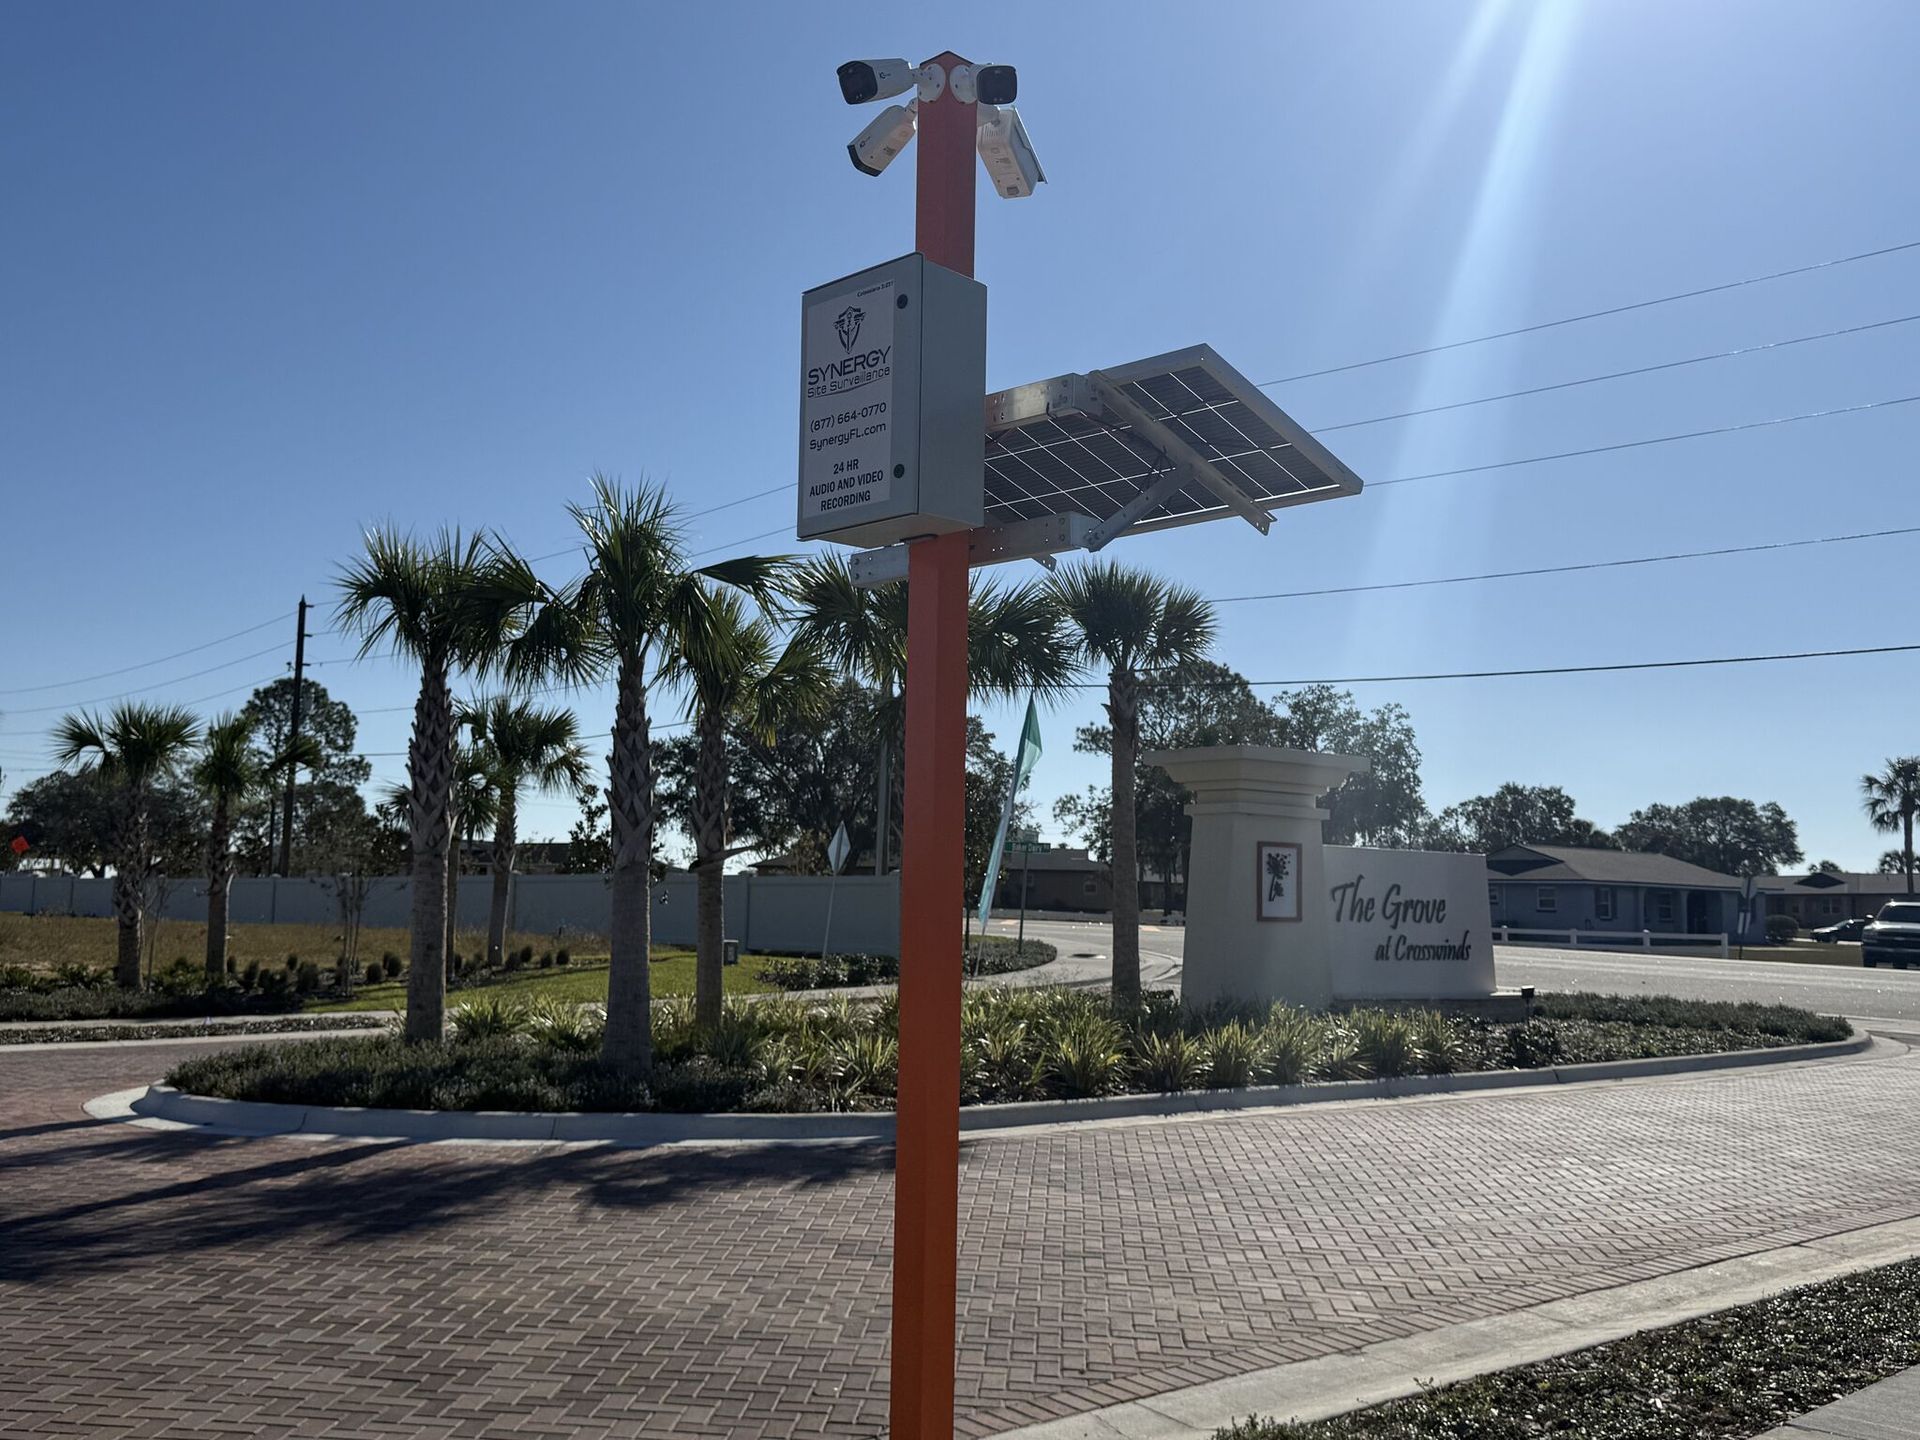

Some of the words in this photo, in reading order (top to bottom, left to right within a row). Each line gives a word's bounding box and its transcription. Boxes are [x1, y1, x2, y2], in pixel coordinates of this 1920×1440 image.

[808, 345, 891, 385] SYNERGY
[807, 385, 827, 398] Site
[830, 366, 890, 391] Surveillance
[810, 414, 835, 433] (877)
[838, 402, 887, 424] 664-0770
[809, 422, 886, 451] SynergyFL.com
[833, 461, 844, 475] 24
[846, 458, 859, 472] HR
[809, 481, 835, 497] AUDIO
[837, 475, 855, 491] AND
[857, 470, 884, 486] VIDEO
[820, 490, 871, 512] RECORDING
[1331, 874, 1376, 923] The
[1382, 883, 1447, 930] Grove
[1375, 935, 1393, 961] at
[1395, 930, 1472, 961] Crosswinds
